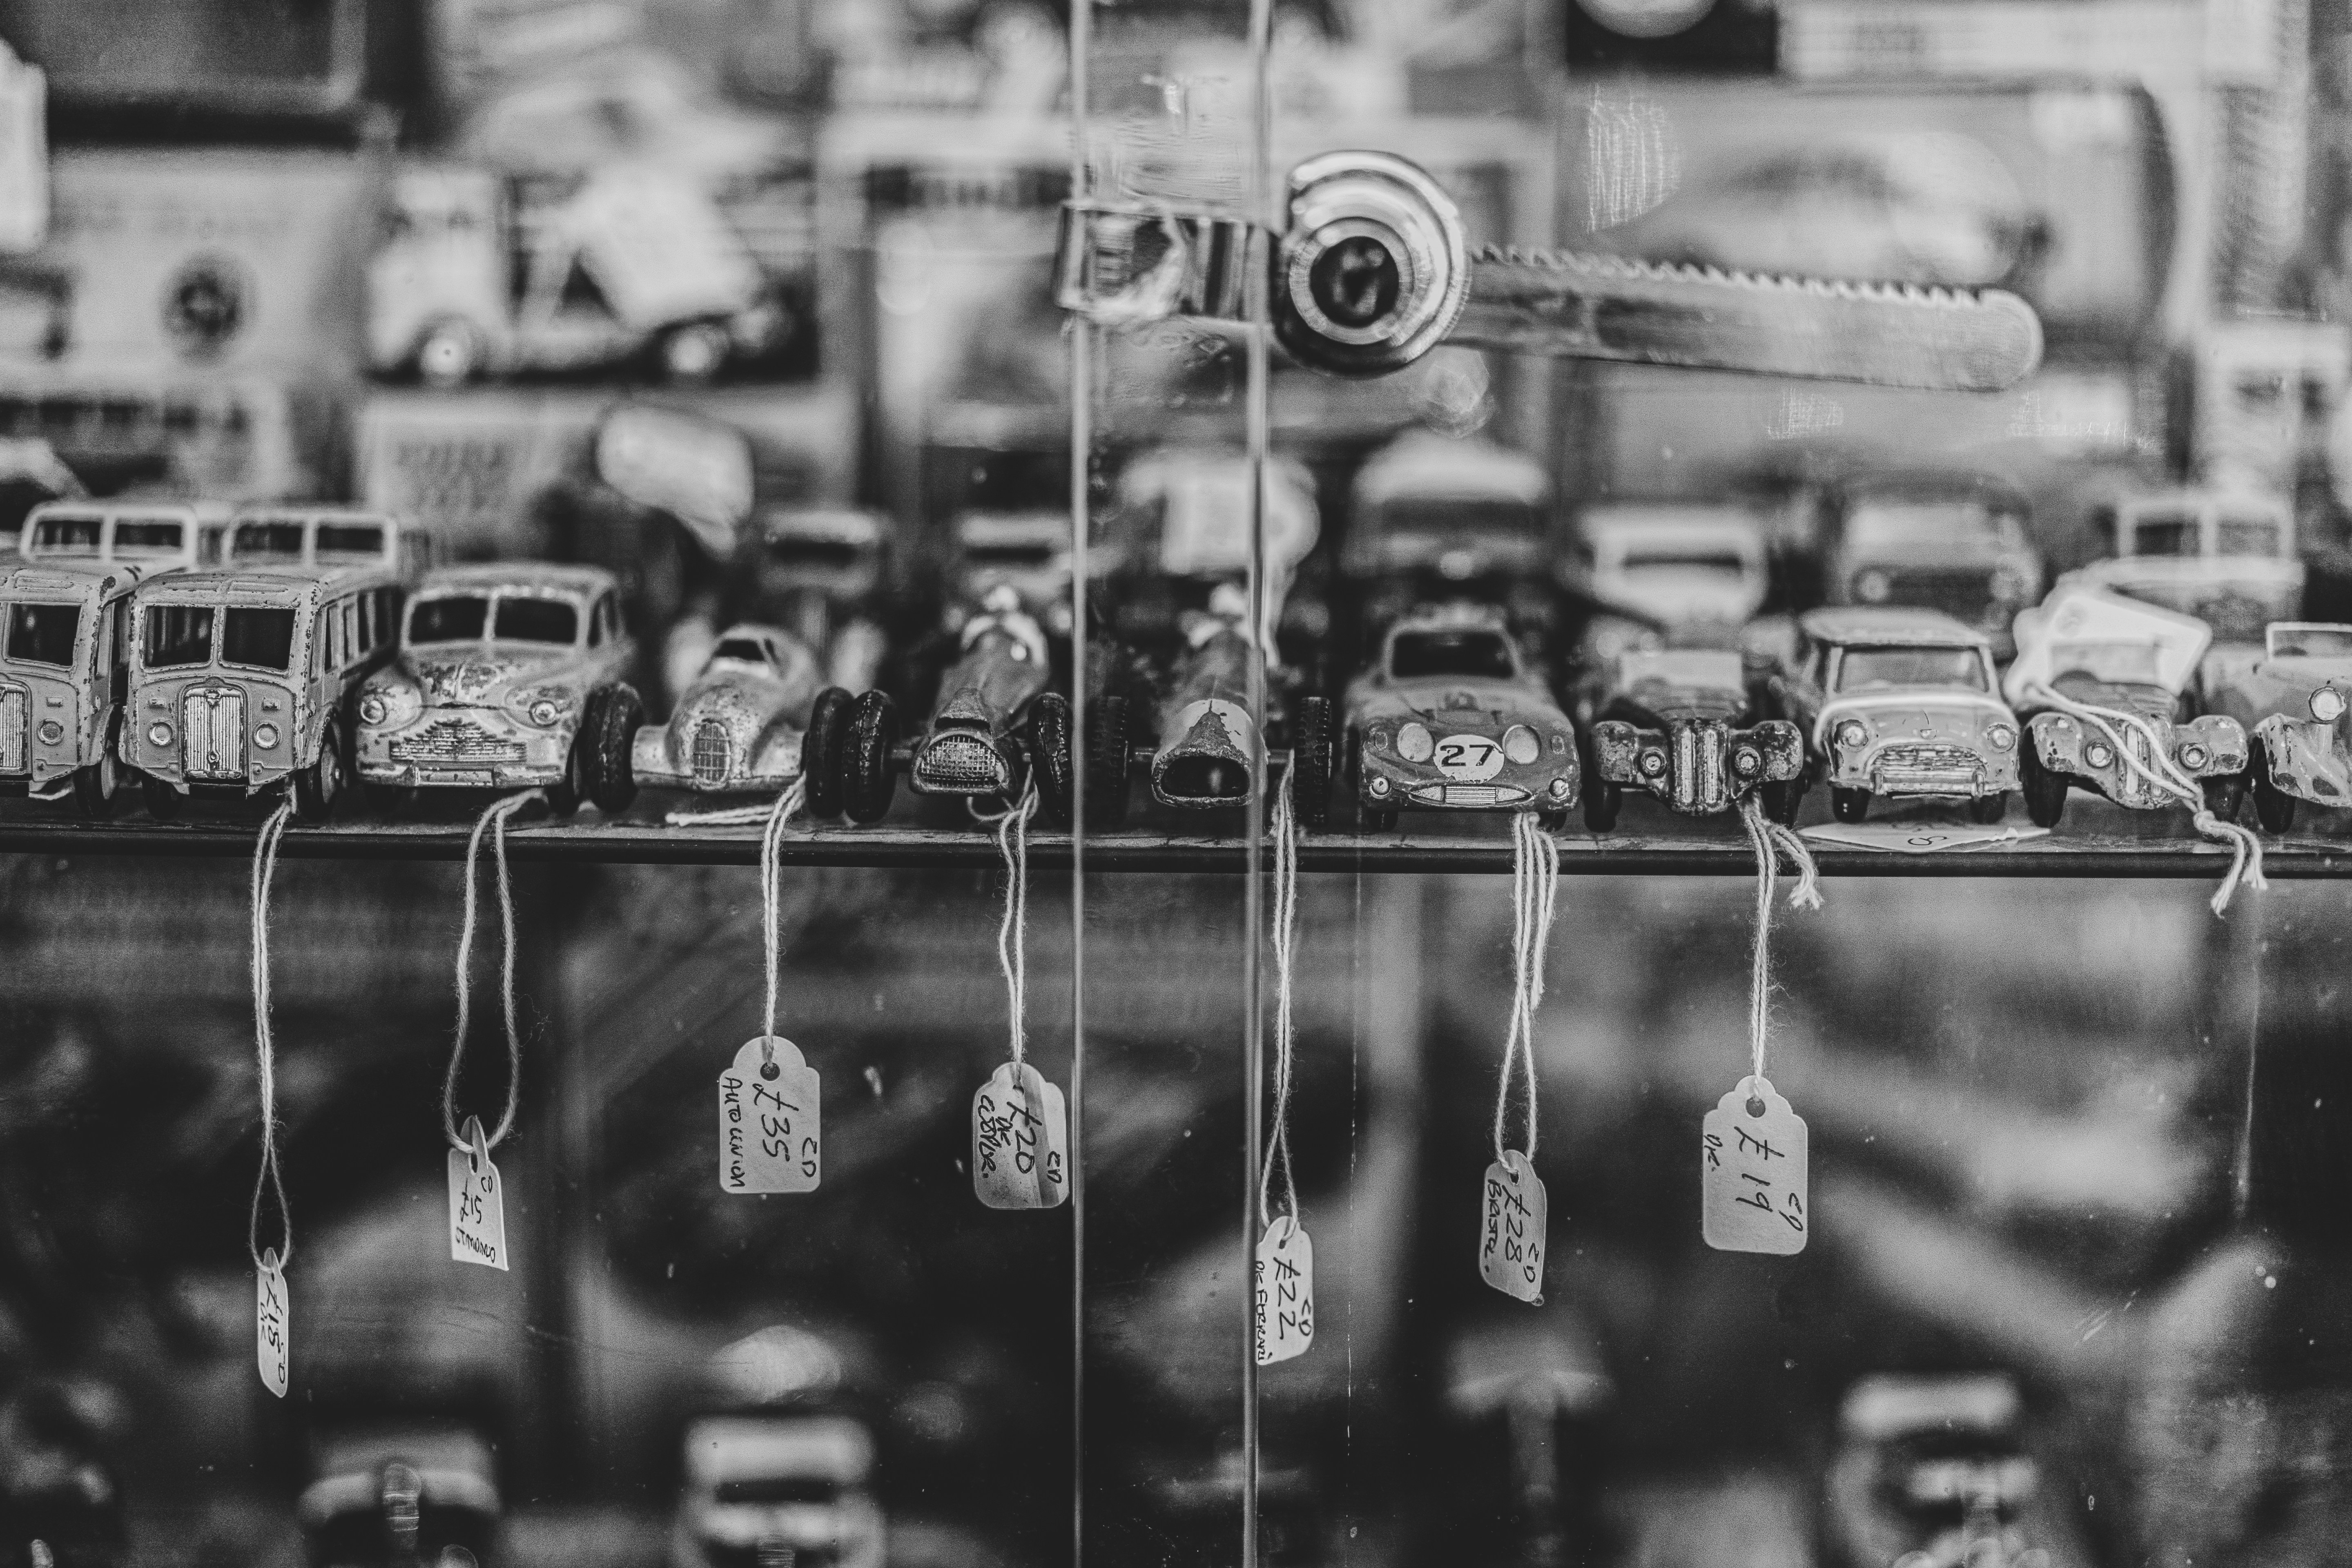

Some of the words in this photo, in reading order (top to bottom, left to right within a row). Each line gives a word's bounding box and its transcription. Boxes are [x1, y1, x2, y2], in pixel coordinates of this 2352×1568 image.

[1440, 744, 1494, 767] 27
[752, 1083, 799, 1162] £35
[1006, 1101, 1042, 1174] £20
[460, 1178, 482, 1224] £15
[1734, 1126, 1785, 1212] £19
[1501, 1184, 1531, 1263] £28
[1273, 1256, 1301, 1340] £22
